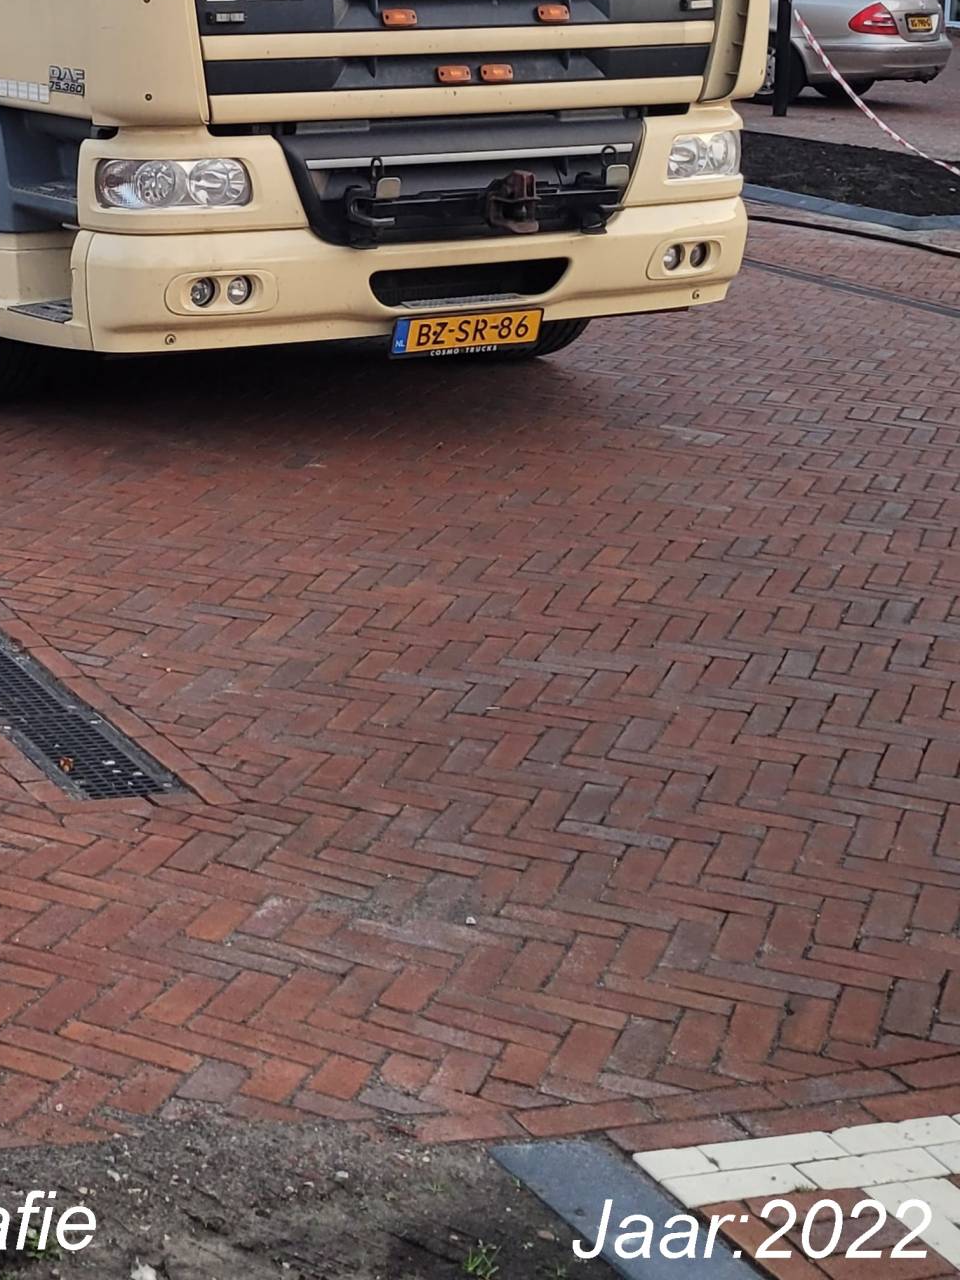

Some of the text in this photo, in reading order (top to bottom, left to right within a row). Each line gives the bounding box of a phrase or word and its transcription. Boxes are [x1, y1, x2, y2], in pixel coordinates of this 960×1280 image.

[49, 65, 85, 82] DAF
[394, 315, 530, 348] NL BZ-SR-86
[430, 348, 460, 357] COSMO
